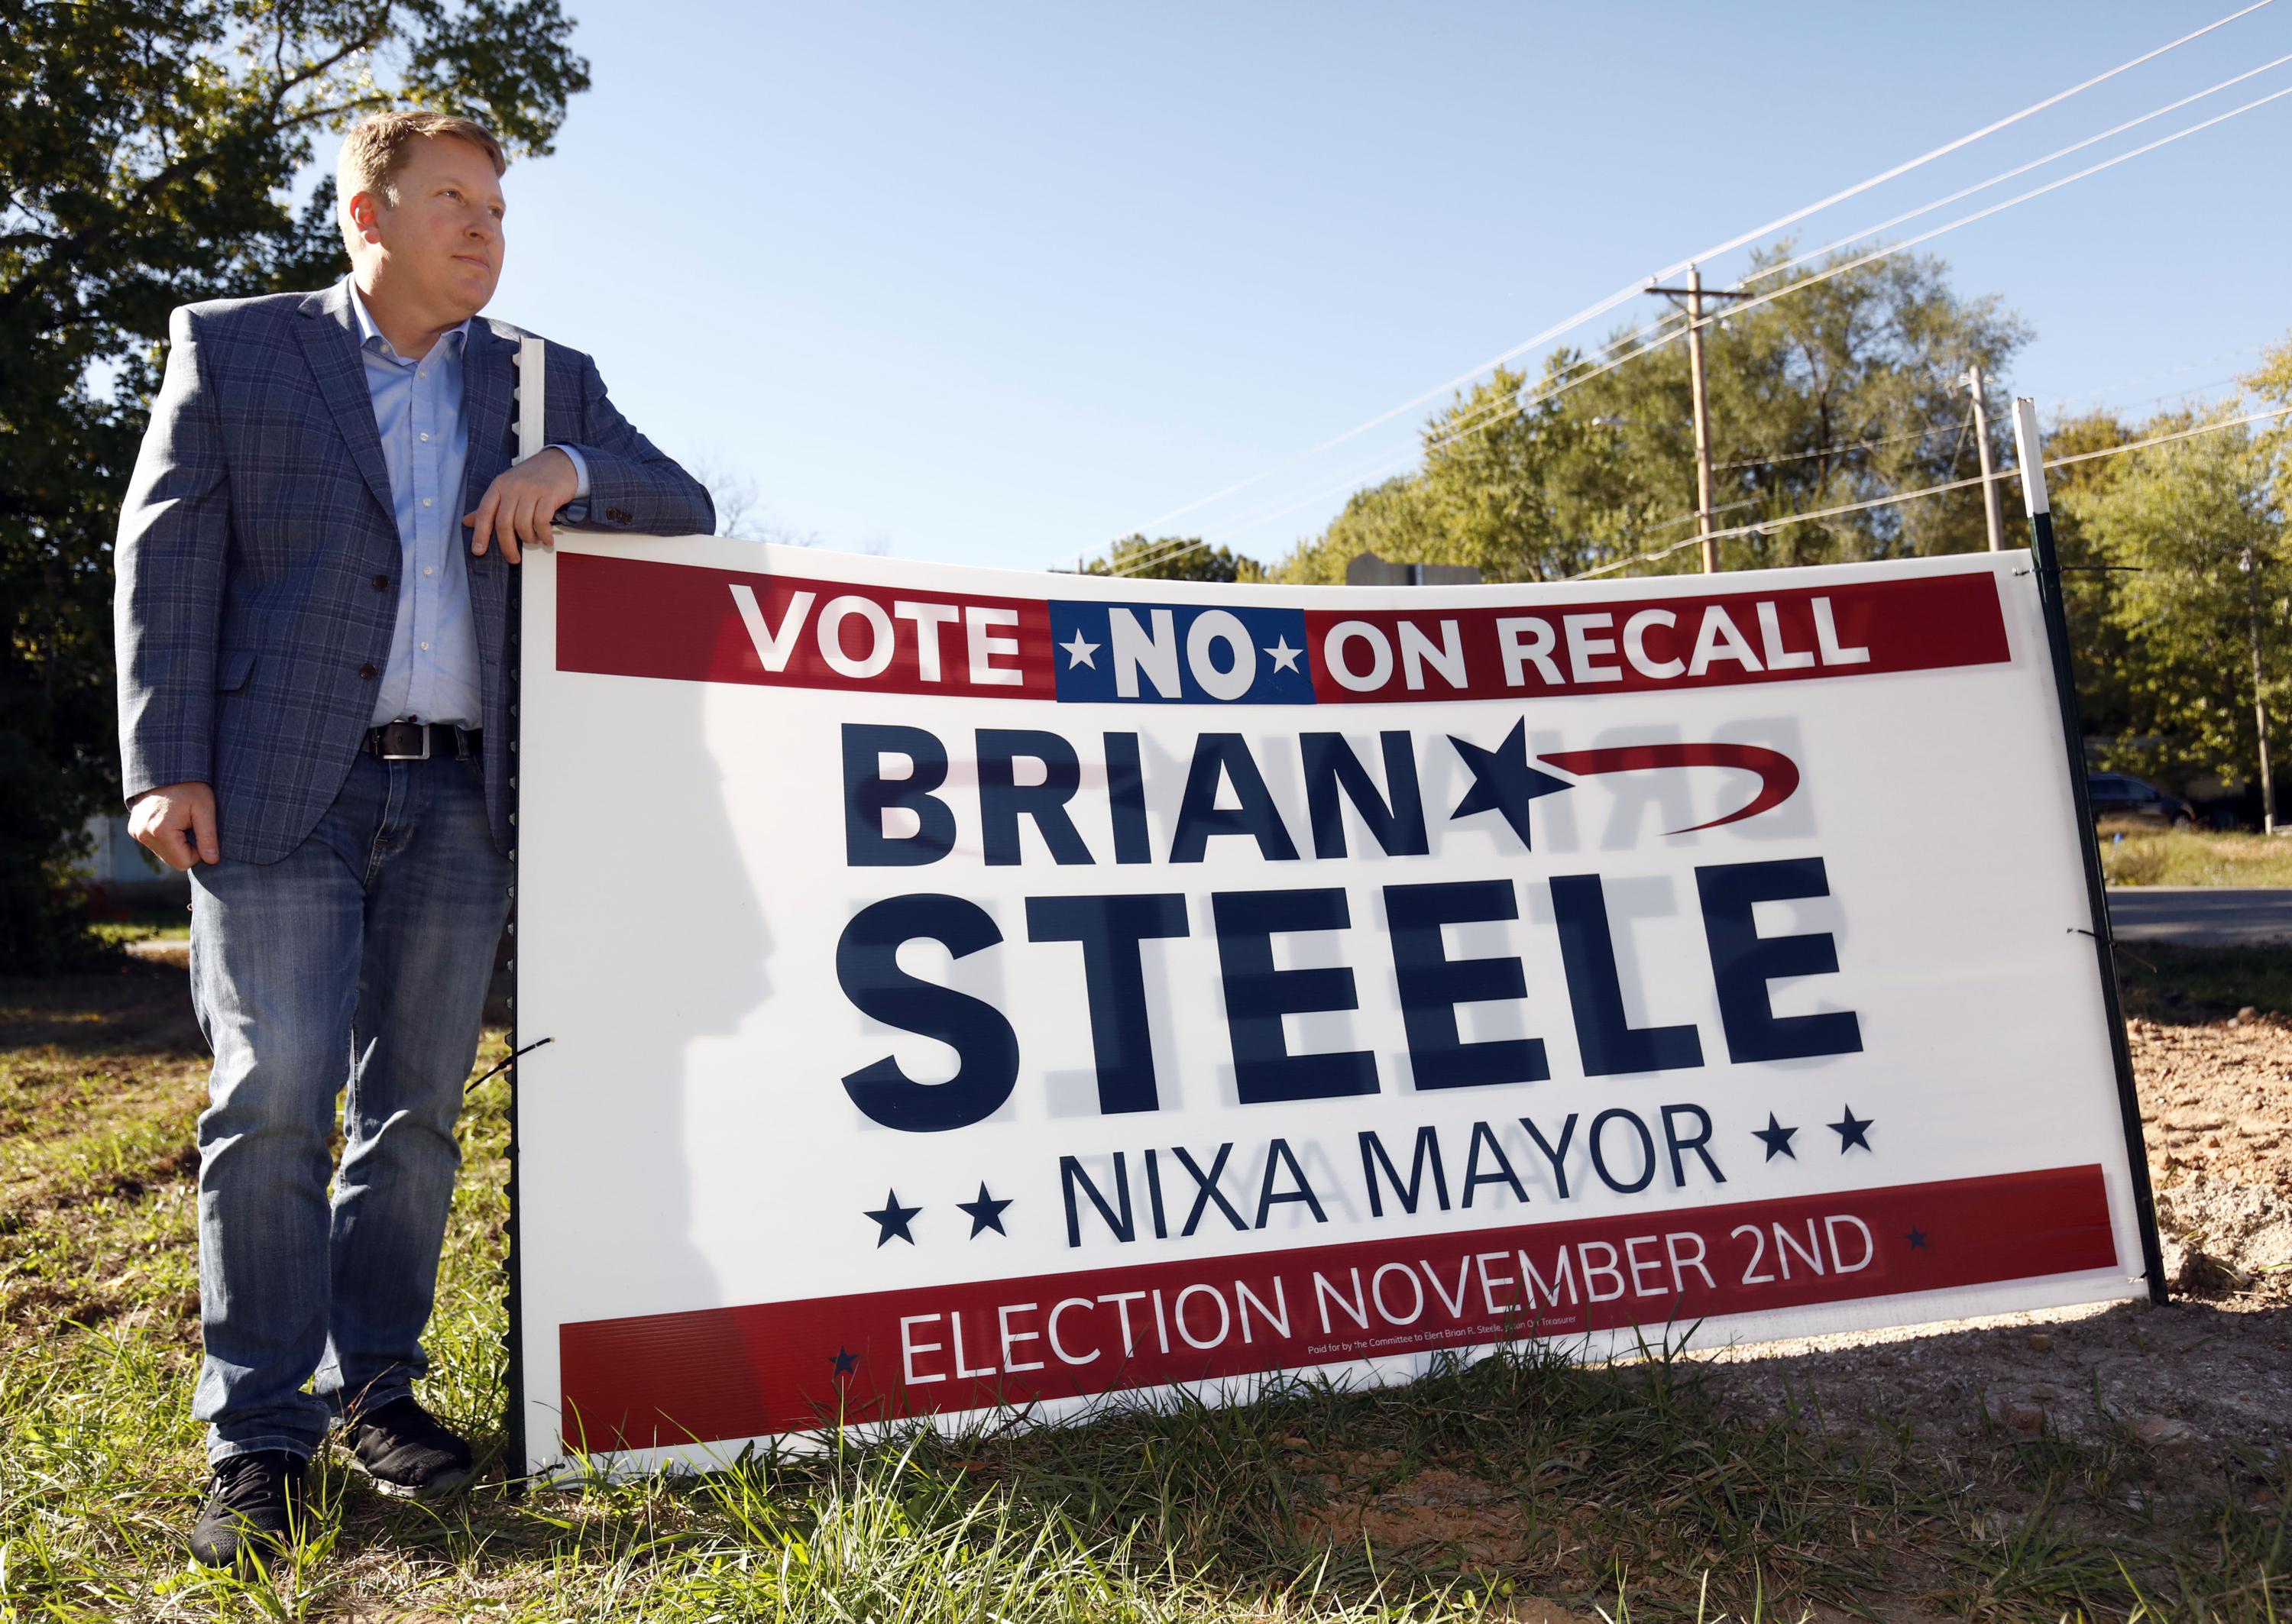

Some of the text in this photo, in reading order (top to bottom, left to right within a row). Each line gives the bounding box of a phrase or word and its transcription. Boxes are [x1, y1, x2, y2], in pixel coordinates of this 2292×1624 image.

[729, 584, 1870, 700] VOTE NO ON RECALL
[841, 723, 1429, 867] BRIAN
[836, 856, 1863, 1132] STEELE
[1059, 1103, 1727, 1247] NIXA MAYOR
[900, 1214, 1873, 1385] ELECTION NOVEMBER 2ND
[1308, 1344, 1327, 1354] Paid
[1342, 1342, 1352, 1351] by
[1368, 1335, 1413, 1347] Committee
[1445, 1329, 1466, 1338] Brian
